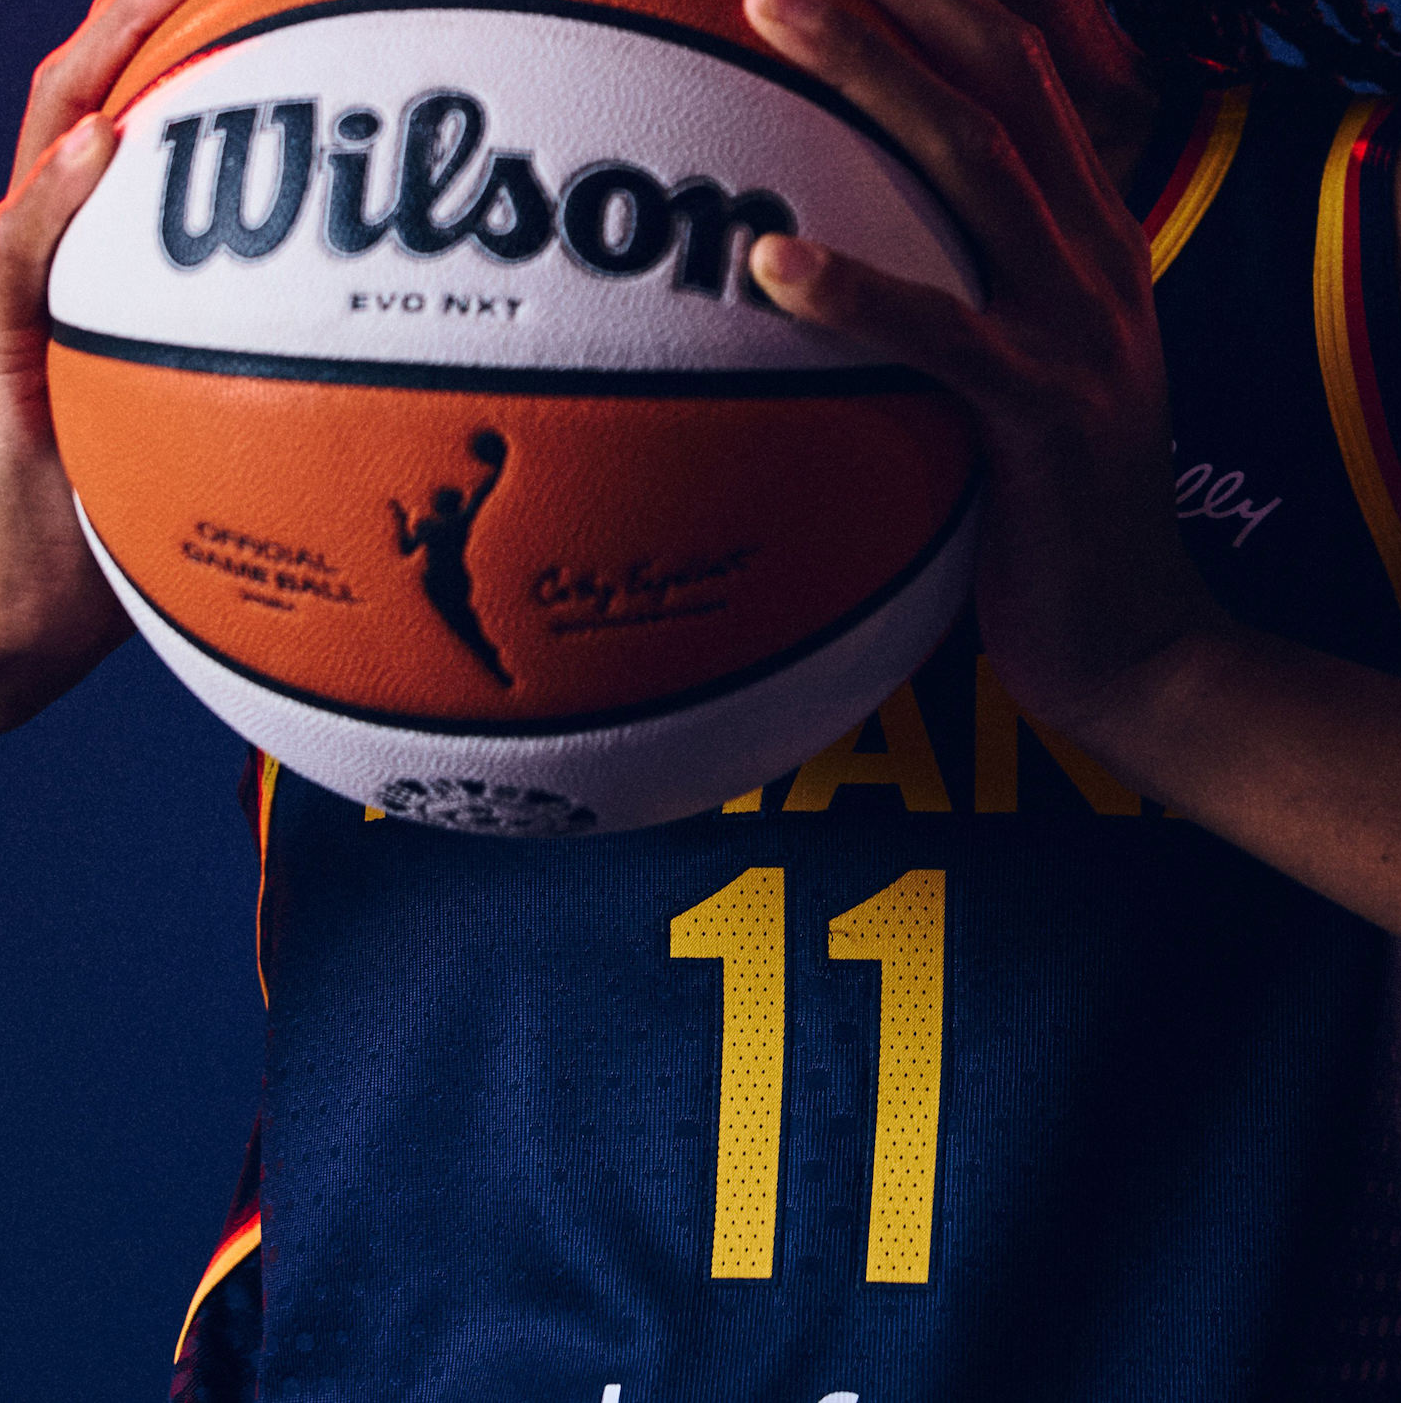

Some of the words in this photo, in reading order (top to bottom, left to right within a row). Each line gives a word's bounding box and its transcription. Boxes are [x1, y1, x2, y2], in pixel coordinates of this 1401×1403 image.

[157, 86, 798, 318] Wilson
[350, 292, 426, 313] EVO
[443, 292, 523, 321] NXT
[1172, 439, 1283, 548] lly
[182, 541, 267, 583] GAME
[275, 571, 363, 605] BALL
[195, 521, 339, 574] OFFICIAL
[669, 866, 946, 1284] 11
